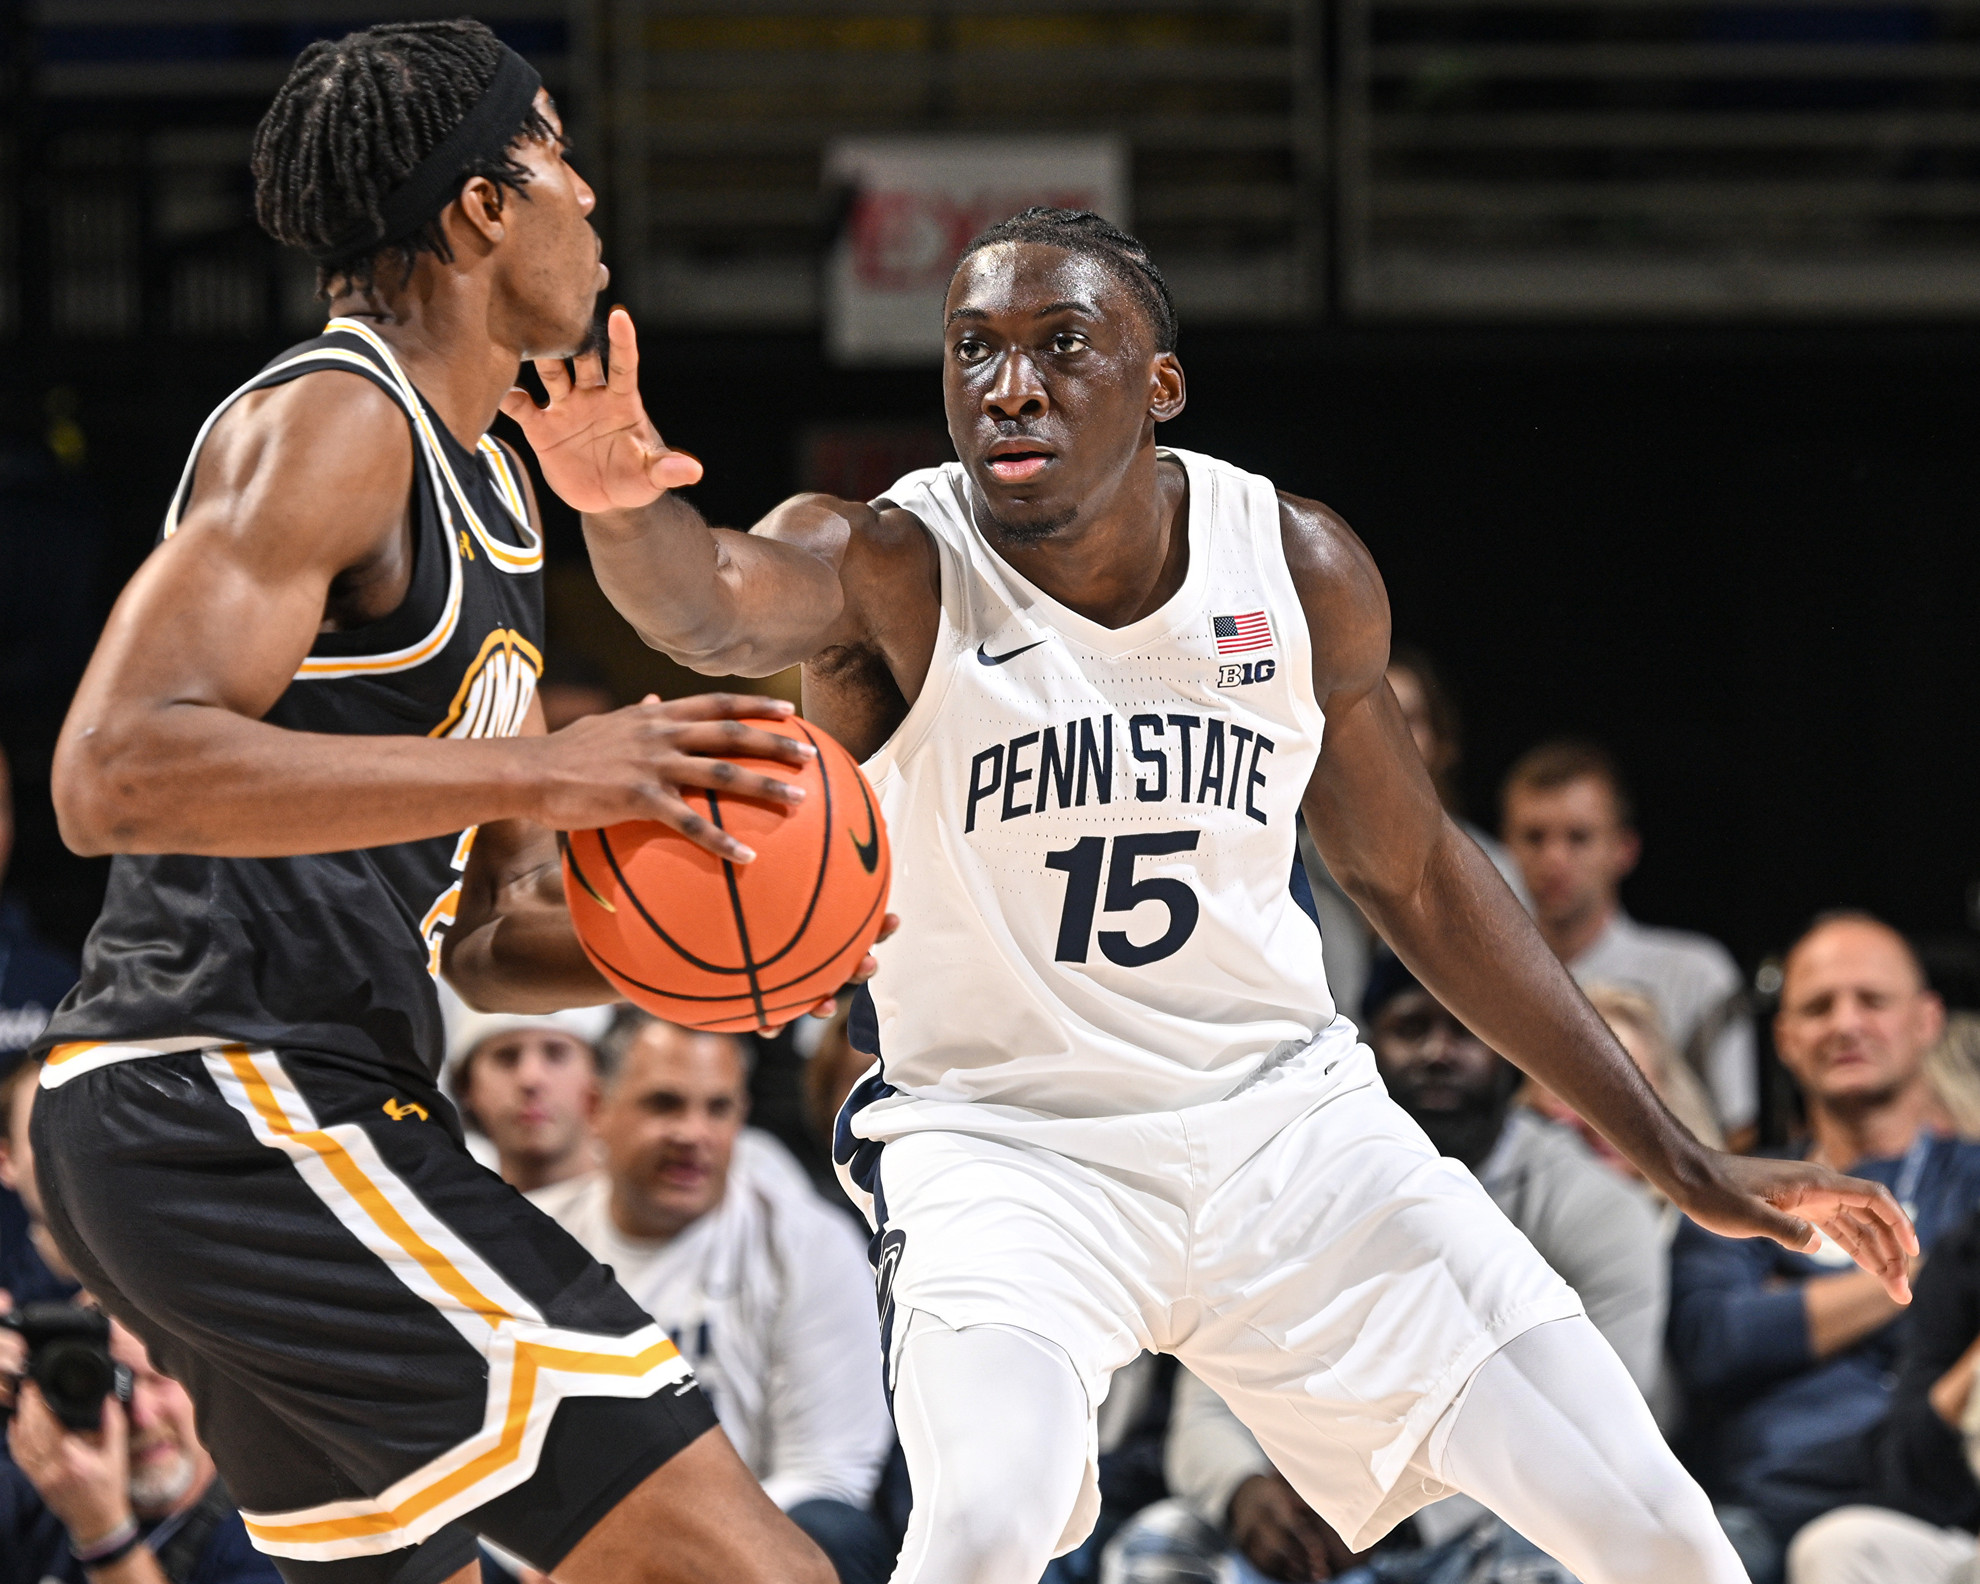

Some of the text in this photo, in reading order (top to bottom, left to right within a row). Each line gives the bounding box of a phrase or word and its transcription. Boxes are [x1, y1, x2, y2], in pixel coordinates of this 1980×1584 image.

[965, 713, 1275, 834] PENN STATE
[1045, 830, 1201, 967] 15
